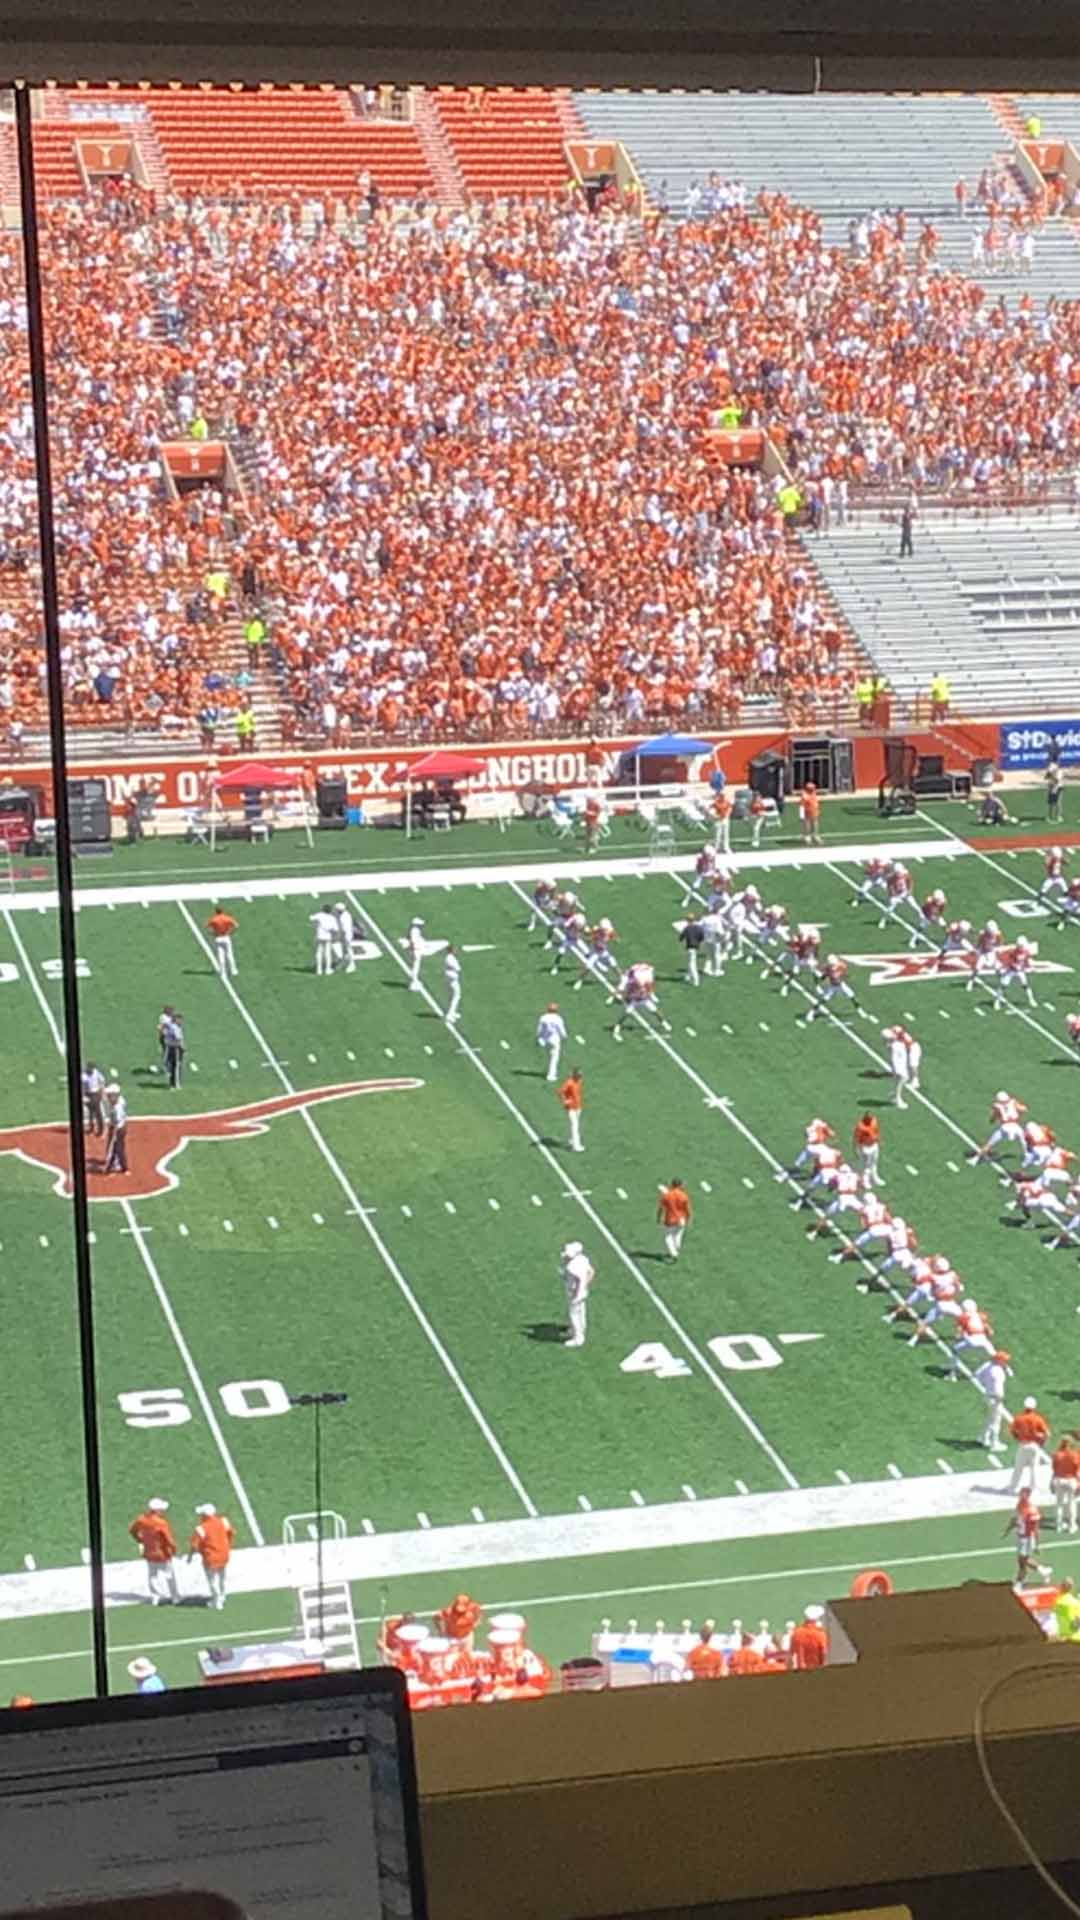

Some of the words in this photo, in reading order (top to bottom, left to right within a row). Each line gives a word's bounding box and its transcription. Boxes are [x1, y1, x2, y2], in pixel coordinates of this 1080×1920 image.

[317, 761, 435, 794] TEXA
[619, 1333, 784, 1378] 40
[116, 1379, 292, 1428] 50
